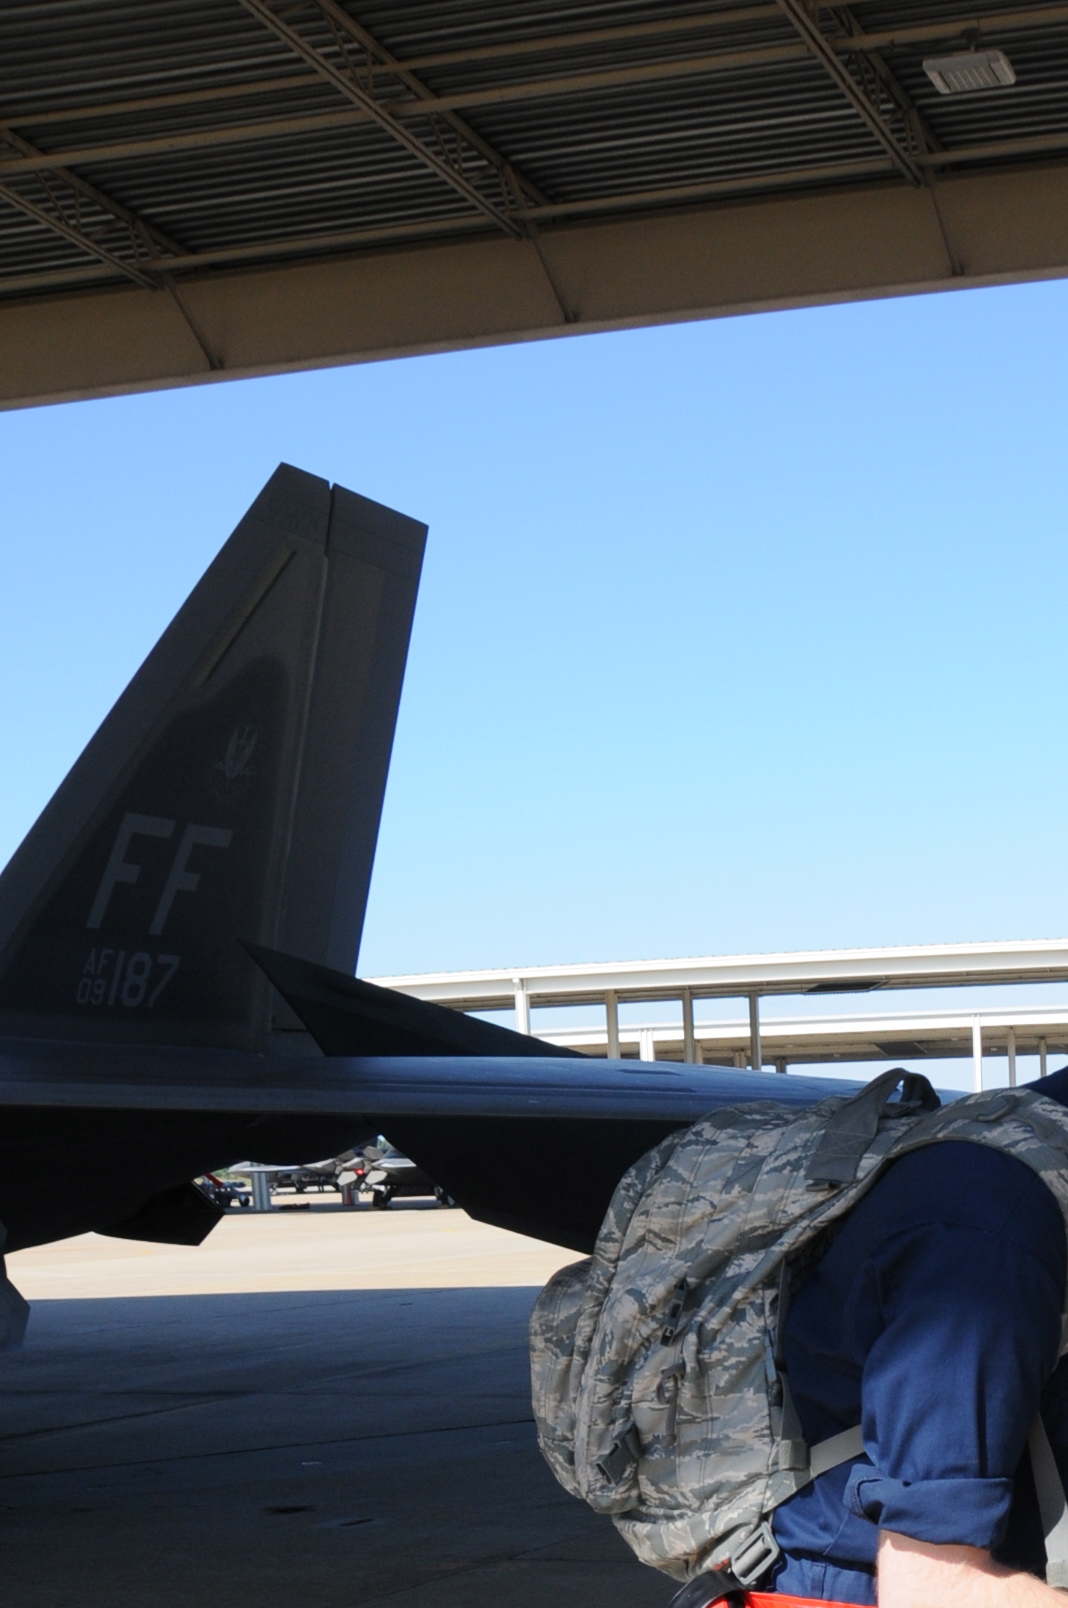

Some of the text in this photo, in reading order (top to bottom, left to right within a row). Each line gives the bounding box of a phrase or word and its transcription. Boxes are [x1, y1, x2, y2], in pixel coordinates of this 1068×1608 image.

[86, 812, 234, 936] FF
[83, 948, 114, 975] AF
[107, 950, 181, 1008] 187
[76, 978, 106, 1005] 09
